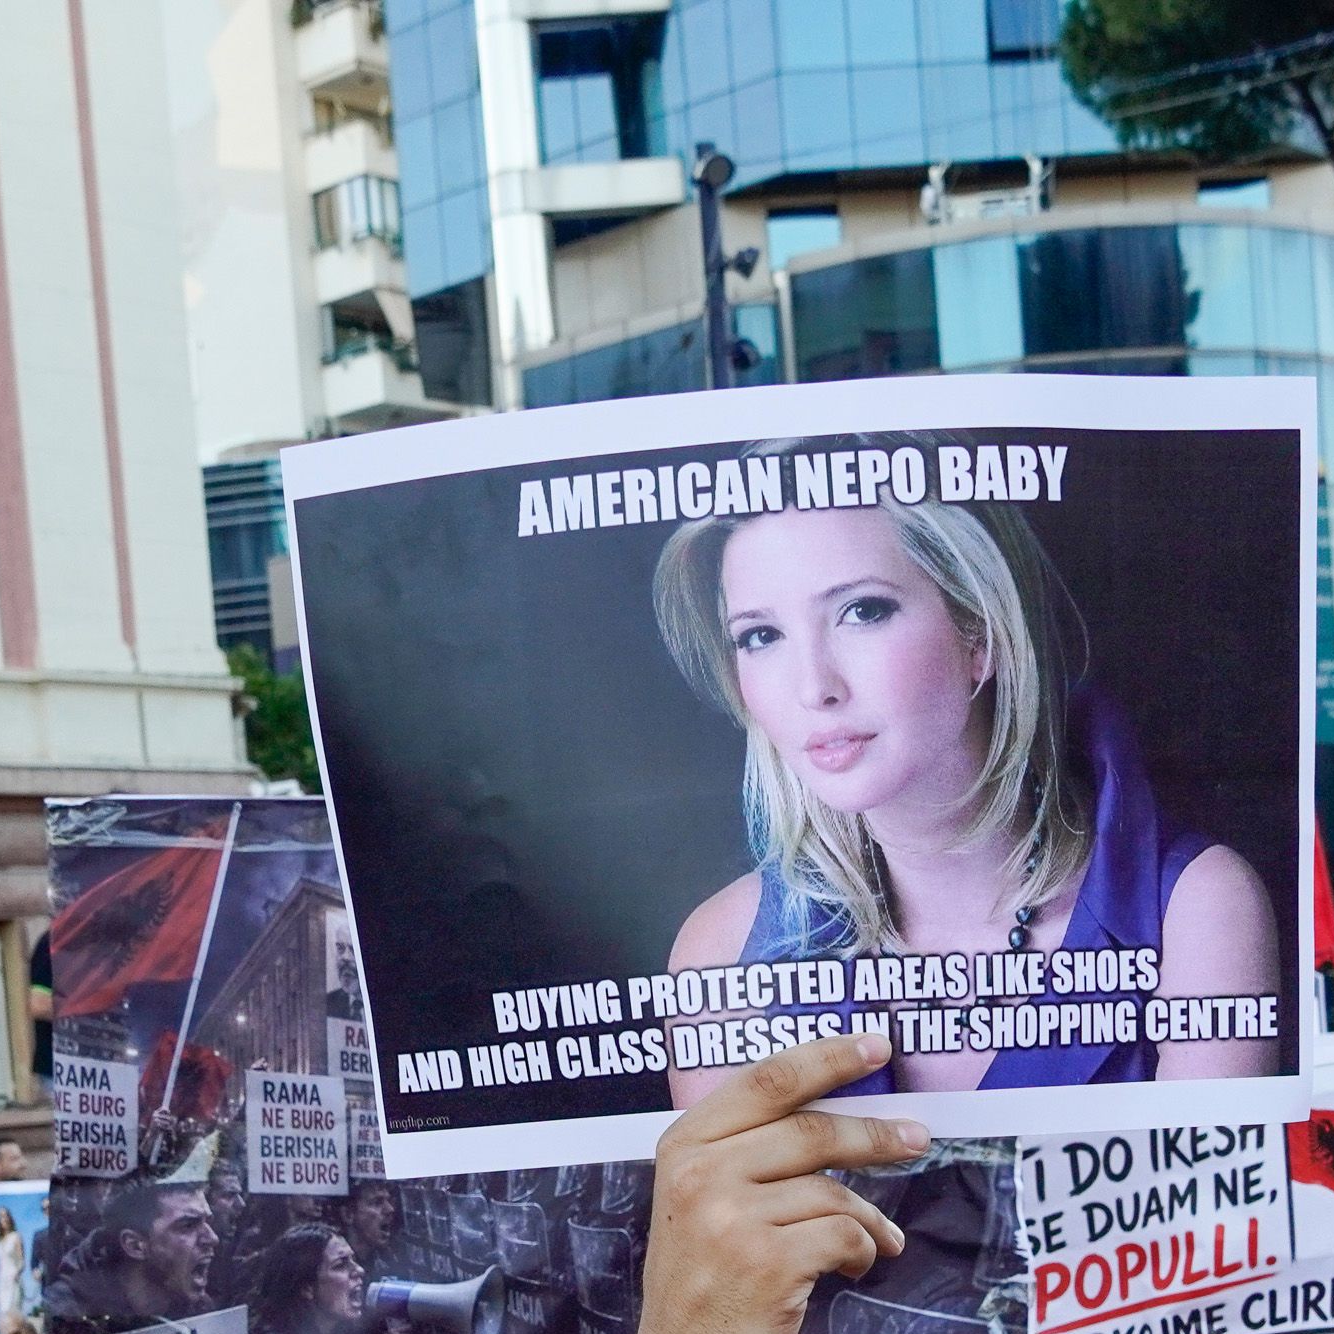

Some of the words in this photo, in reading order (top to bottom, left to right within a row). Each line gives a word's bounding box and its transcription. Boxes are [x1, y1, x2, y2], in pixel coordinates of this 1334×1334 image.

[518, 455, 785, 537] AMERICAN
[794, 446, 928, 510] NEPO
[937, 445, 1068, 502] BABY
[493, 975, 623, 1034] BUYING
[629, 959, 845, 1020] PROTECTED
[852, 954, 968, 1002] AREAS
[975, 952, 1046, 995] LIKE
[1051, 948, 1160, 994] SHOES
[397, 1048, 464, 1095] AND
[468, 1039, 554, 1088] HIGH
[556, 1028, 670, 1081] CLASS
[897, 1009, 964, 1054] THE
[968, 1002, 1137, 1051] SHOPPING
[1144, 996, 1279, 1042] CENTRE
[54, 1062, 112, 1092] RAMA
[79, 1093, 126, 1118] BURG
[263, 1081, 322, 1106] RAMA
[262, 1108, 284, 1129] NE
[291, 1109, 335, 1130] BURG
[389, 1115, 450, 1130] imgflip.com
[79, 1147, 128, 1171] BURG
[260, 1135, 338, 1159] BERISHA
[261, 1162, 286, 1185] NE
[293, 1163, 339, 1185] BURG
[1062, 1136, 1134, 1197] DO
[1081, 1177, 1198, 1243] DUAM
[1213, 1161, 1278, 1211] NE,
[1034, 1216, 1277, 1325] POPULLI.
